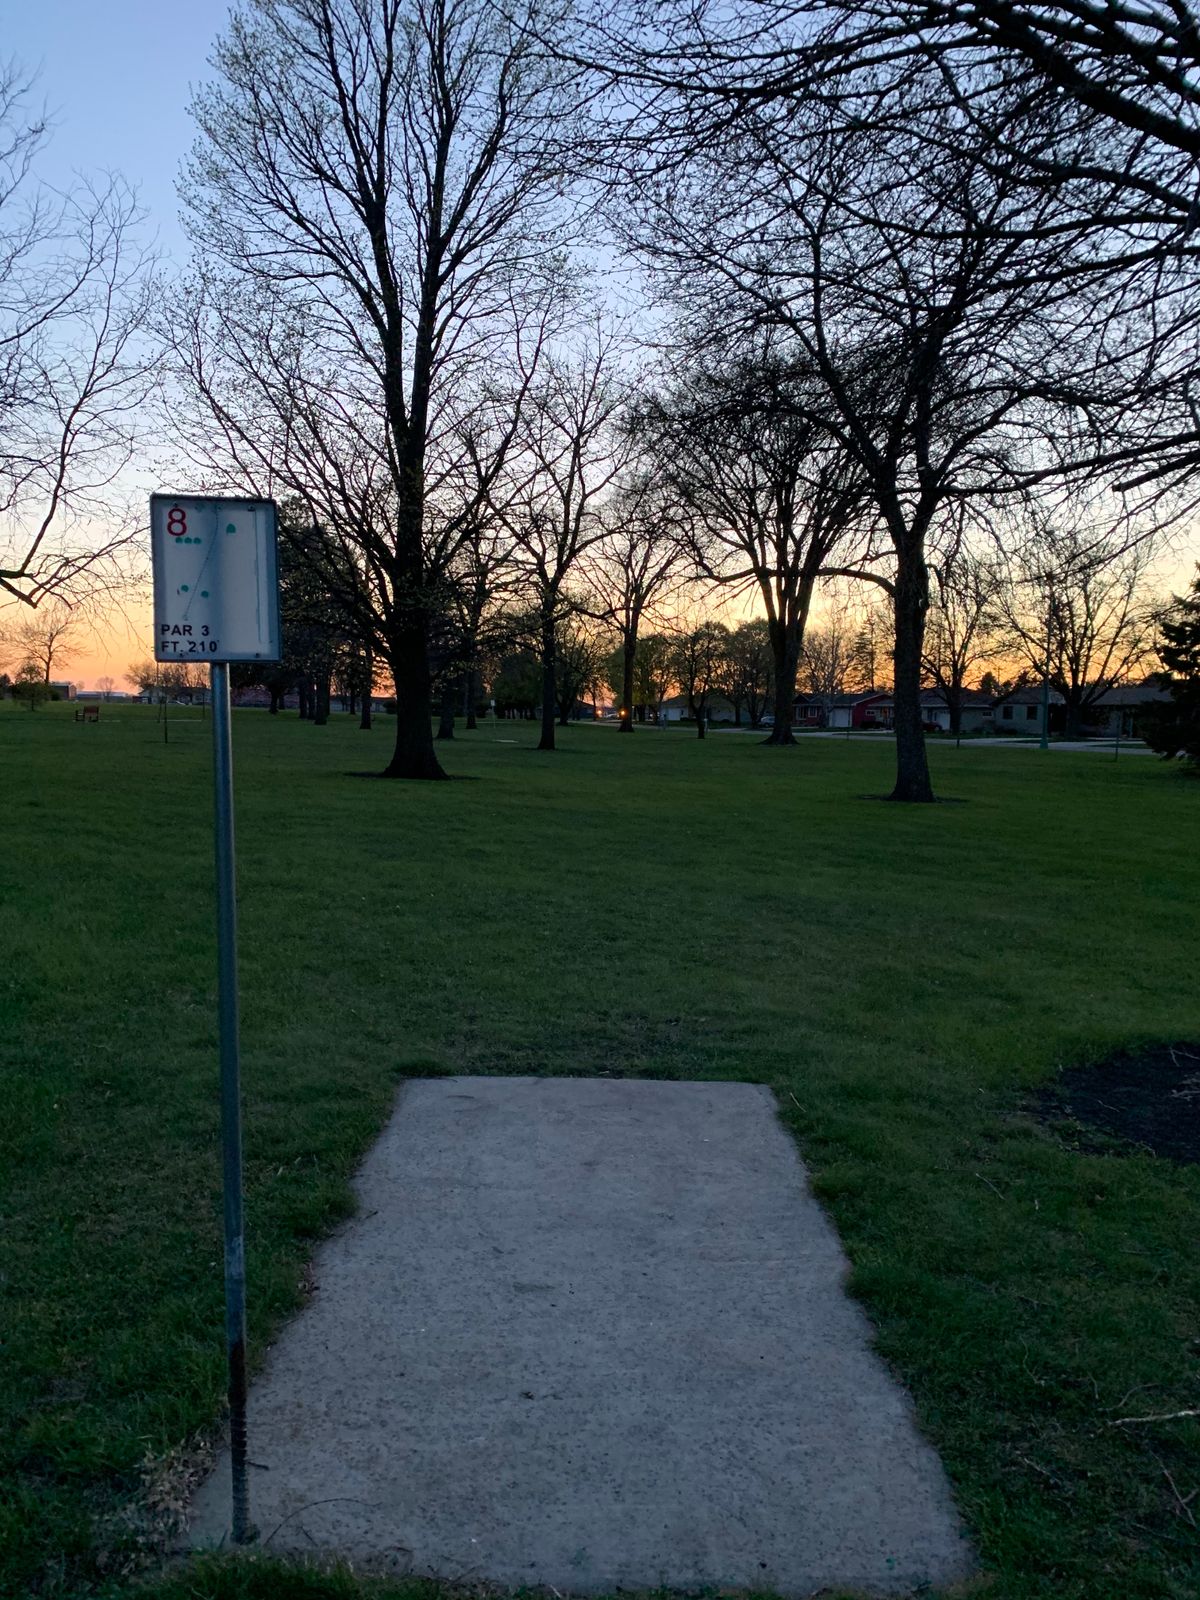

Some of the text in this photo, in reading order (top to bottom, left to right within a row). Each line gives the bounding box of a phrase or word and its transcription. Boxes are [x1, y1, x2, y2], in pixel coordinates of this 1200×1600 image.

[167, 508, 187, 536] 8
[161, 624, 210, 636] PAR 3
[188, 641, 218, 652] 210
